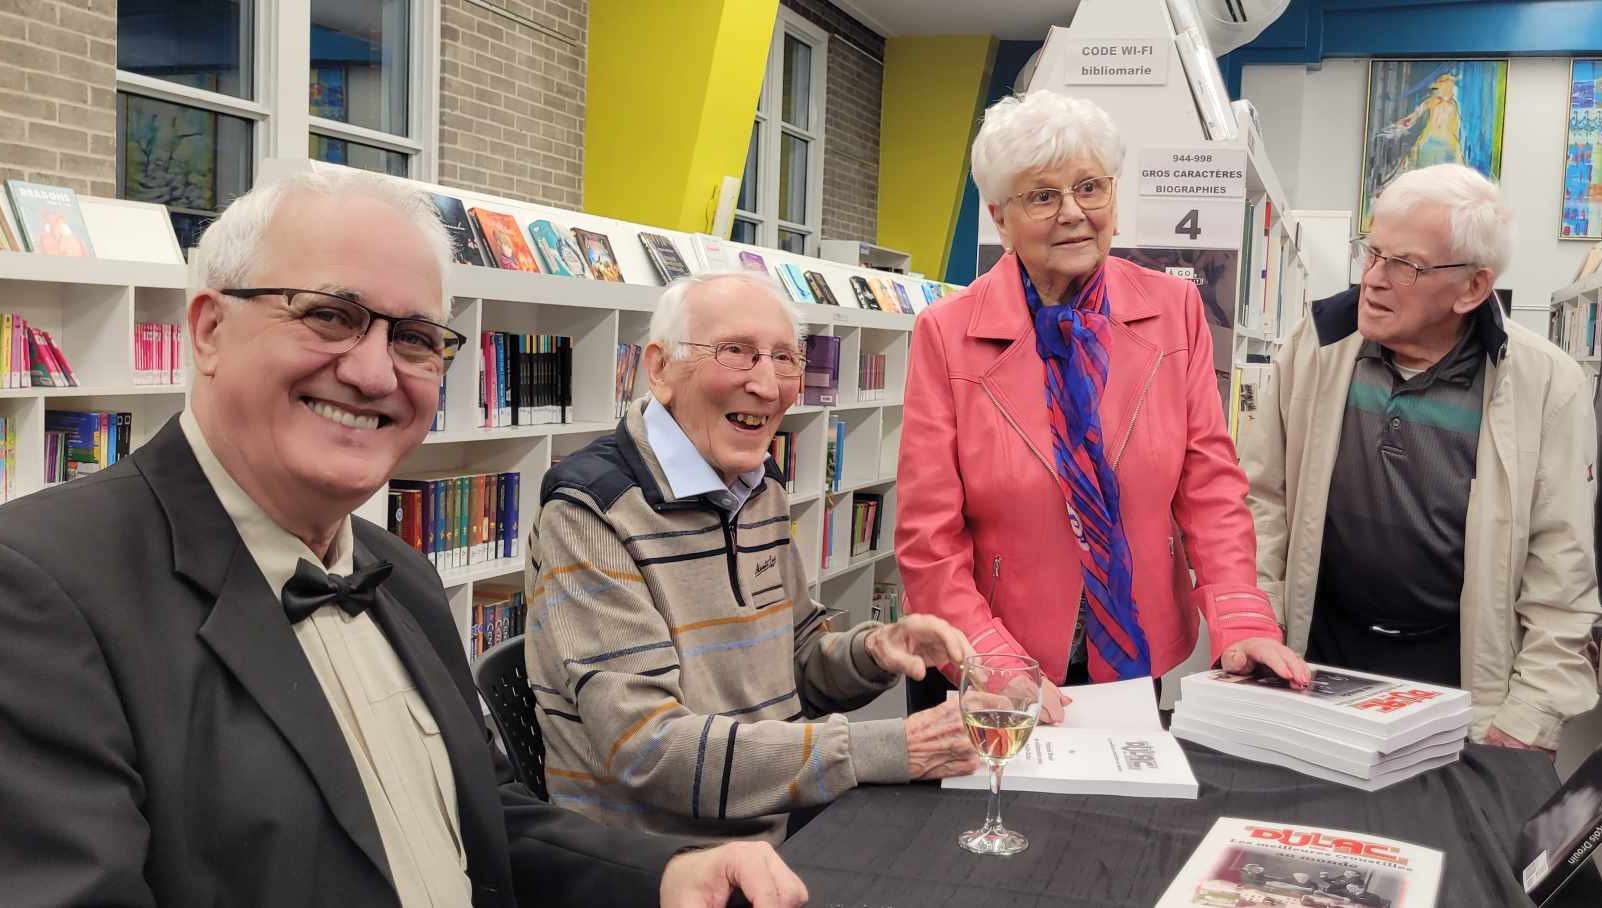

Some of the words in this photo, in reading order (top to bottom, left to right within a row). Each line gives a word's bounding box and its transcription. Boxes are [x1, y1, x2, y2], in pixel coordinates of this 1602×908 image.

[1082, 46, 1117, 56] CODE
[1121, 45, 1153, 56] WI-FI
[1081, 65, 1152, 76] bibliomarie
[1172, 154, 1213, 163] 944-998
[1142, 169, 1170, 178] GROS
[1155, 185, 1227, 194] BIOGRAPHIES
[1174, 209, 1202, 240] 4
[1245, 826, 1408, 865] DULAC
[1568, 842, 1592, 864] Drouin
